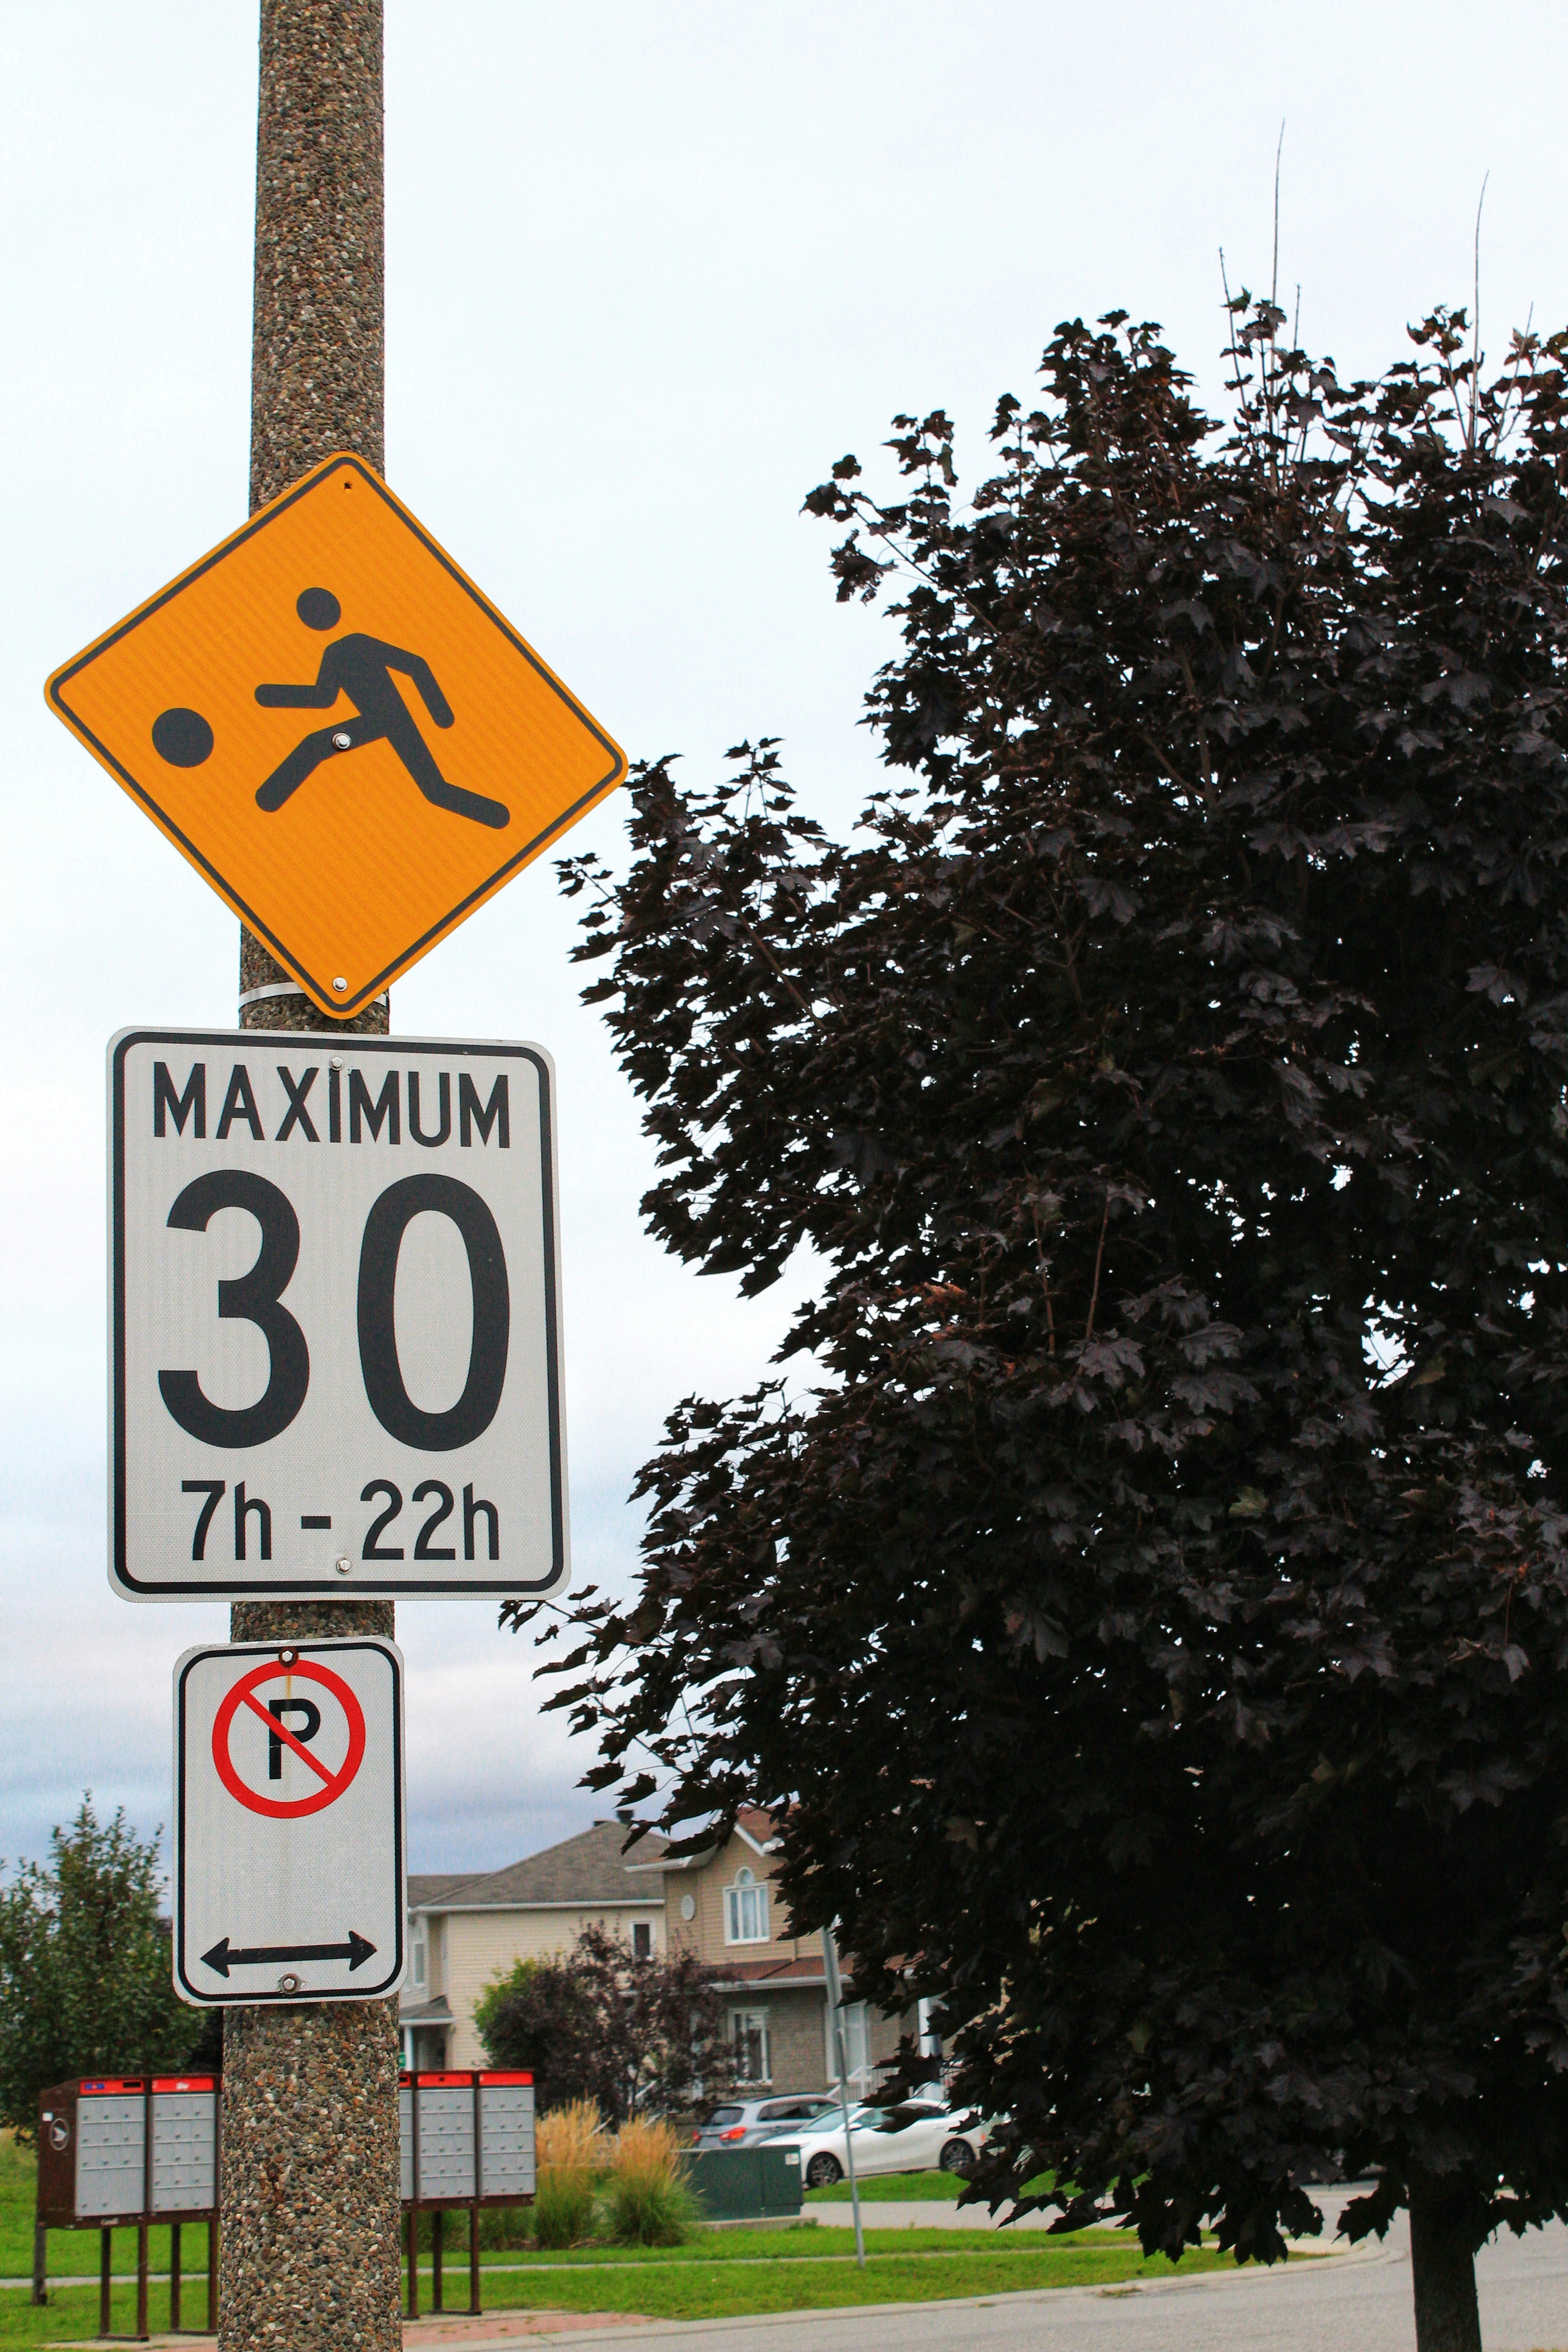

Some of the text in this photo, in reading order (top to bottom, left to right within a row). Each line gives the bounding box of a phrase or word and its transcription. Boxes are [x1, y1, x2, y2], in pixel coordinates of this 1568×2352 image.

[153, 1061, 510, 1149] MAXIMUM
[157, 1169, 510, 1452] 30
[181, 1480, 272, 1561] 7h
[360, 1479, 500, 1561] 22h
[268, 1698, 321, 1780] P
